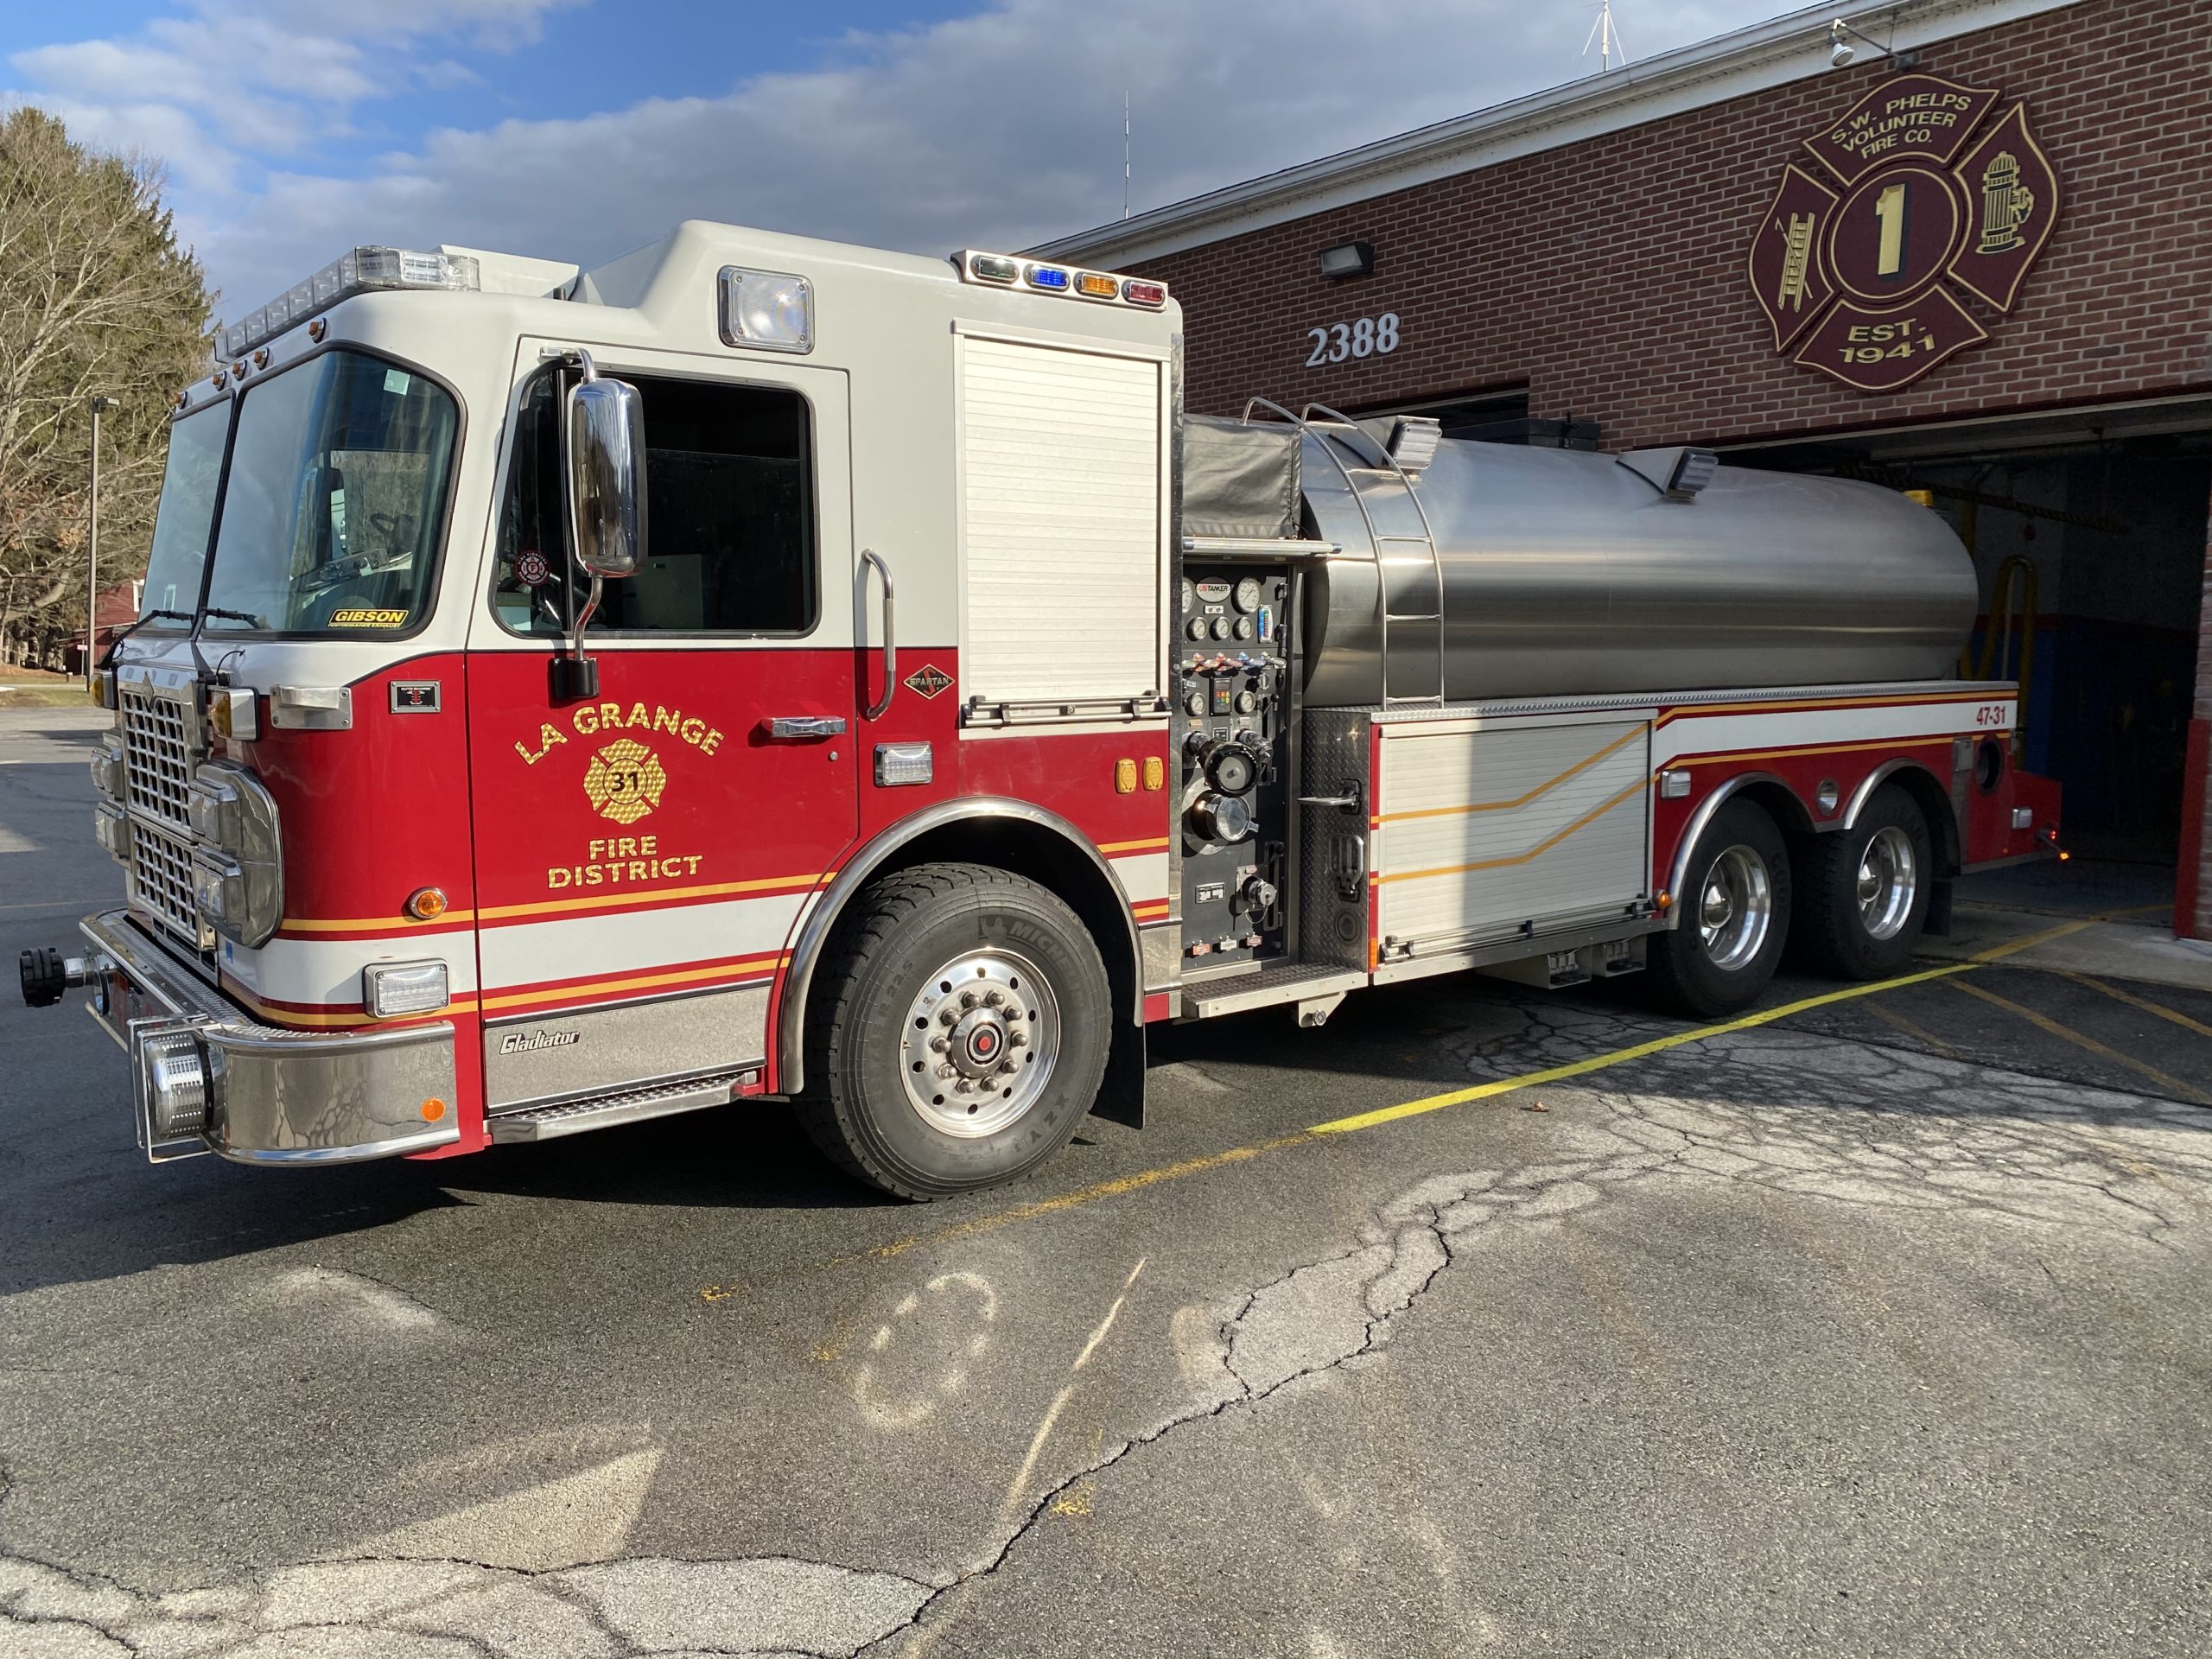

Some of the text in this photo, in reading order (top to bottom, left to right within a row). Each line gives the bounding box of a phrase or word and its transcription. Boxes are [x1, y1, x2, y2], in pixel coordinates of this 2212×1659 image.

[1831, 92, 1972, 144] S.W. PHELPS
[1841, 111, 1957, 154] VOLUNTEER
[1860, 128, 1934, 160] FIRE CO.
[1875, 182, 1906, 276] 1
[1305, 312, 1400, 367] 2388
[1847, 318, 1928, 343] EST.
[1837, 334, 1937, 365] 1941
[334, 611, 404, 622] GIBSON
[1976, 705, 2006, 725] 47-31
[513, 702, 725, 766] LA GRANGE
[611, 771, 639, 792] 31
[588, 836, 657, 861] FIRE
[547, 855, 703, 889] DISTRICT
[499, 1030, 581, 1055] Gladiator
